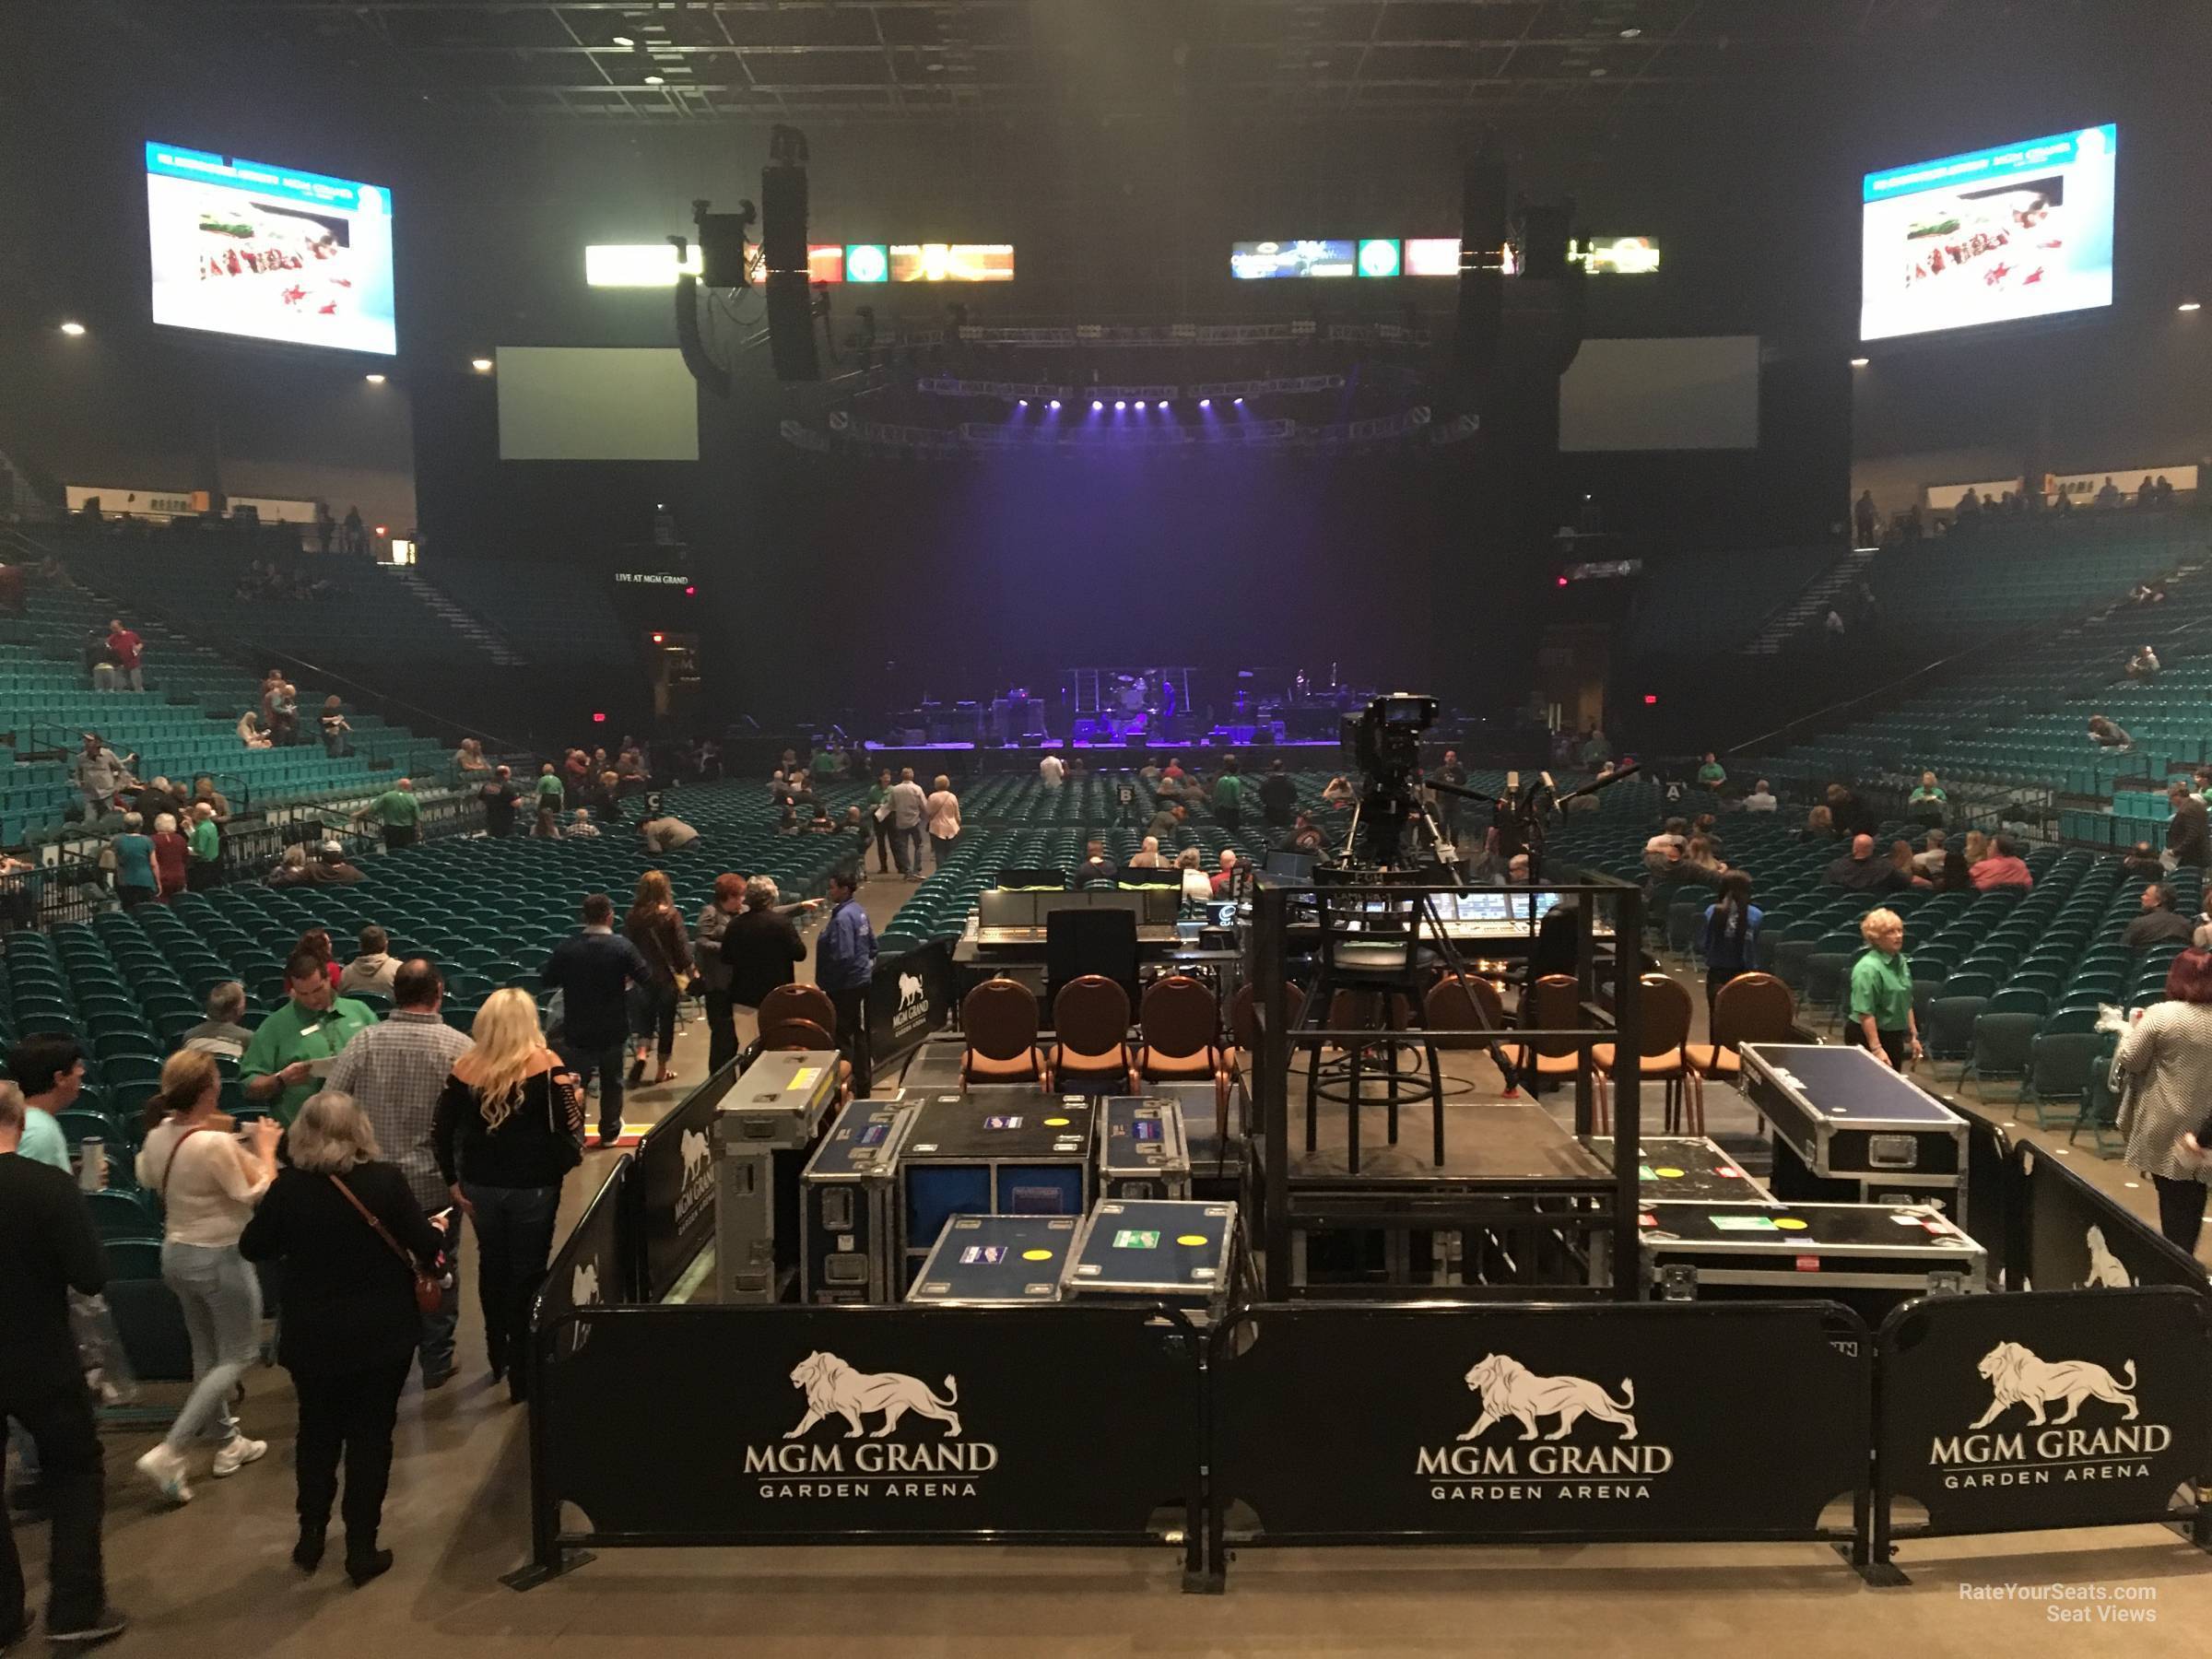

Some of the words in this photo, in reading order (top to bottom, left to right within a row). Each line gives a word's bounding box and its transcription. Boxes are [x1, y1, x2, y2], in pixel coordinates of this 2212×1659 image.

[616, 573, 631, 582] LIVE
[633, 574, 642, 582] AT
[643, 575, 662, 583] MGM
[663, 576, 688, 584] GRAND
[1120, 789, 1132, 801] B
[1666, 785, 1680, 798] A
[648, 794, 659, 807] C
[693, 1164, 715, 1201] GRAN
[1928, 1432, 2028, 1465] MGM
[2037, 1424, 2172, 1459] GRAND
[744, 1443, 844, 1473] MGM
[854, 1443, 998, 1472] GRAND
[1416, 1446, 1518, 1475] MGM
[1528, 1446, 1674, 1475] GRAND
[1945, 1471, 2050, 1489] GARDEN
[2064, 1464, 2150, 1482] ARENA
[759, 1483, 869, 1499] GARDEN
[885, 1483, 977, 1498] ARENA
[1430, 1485, 1542, 1500] GARDEN
[1558, 1485, 1650, 1500] ARENA
